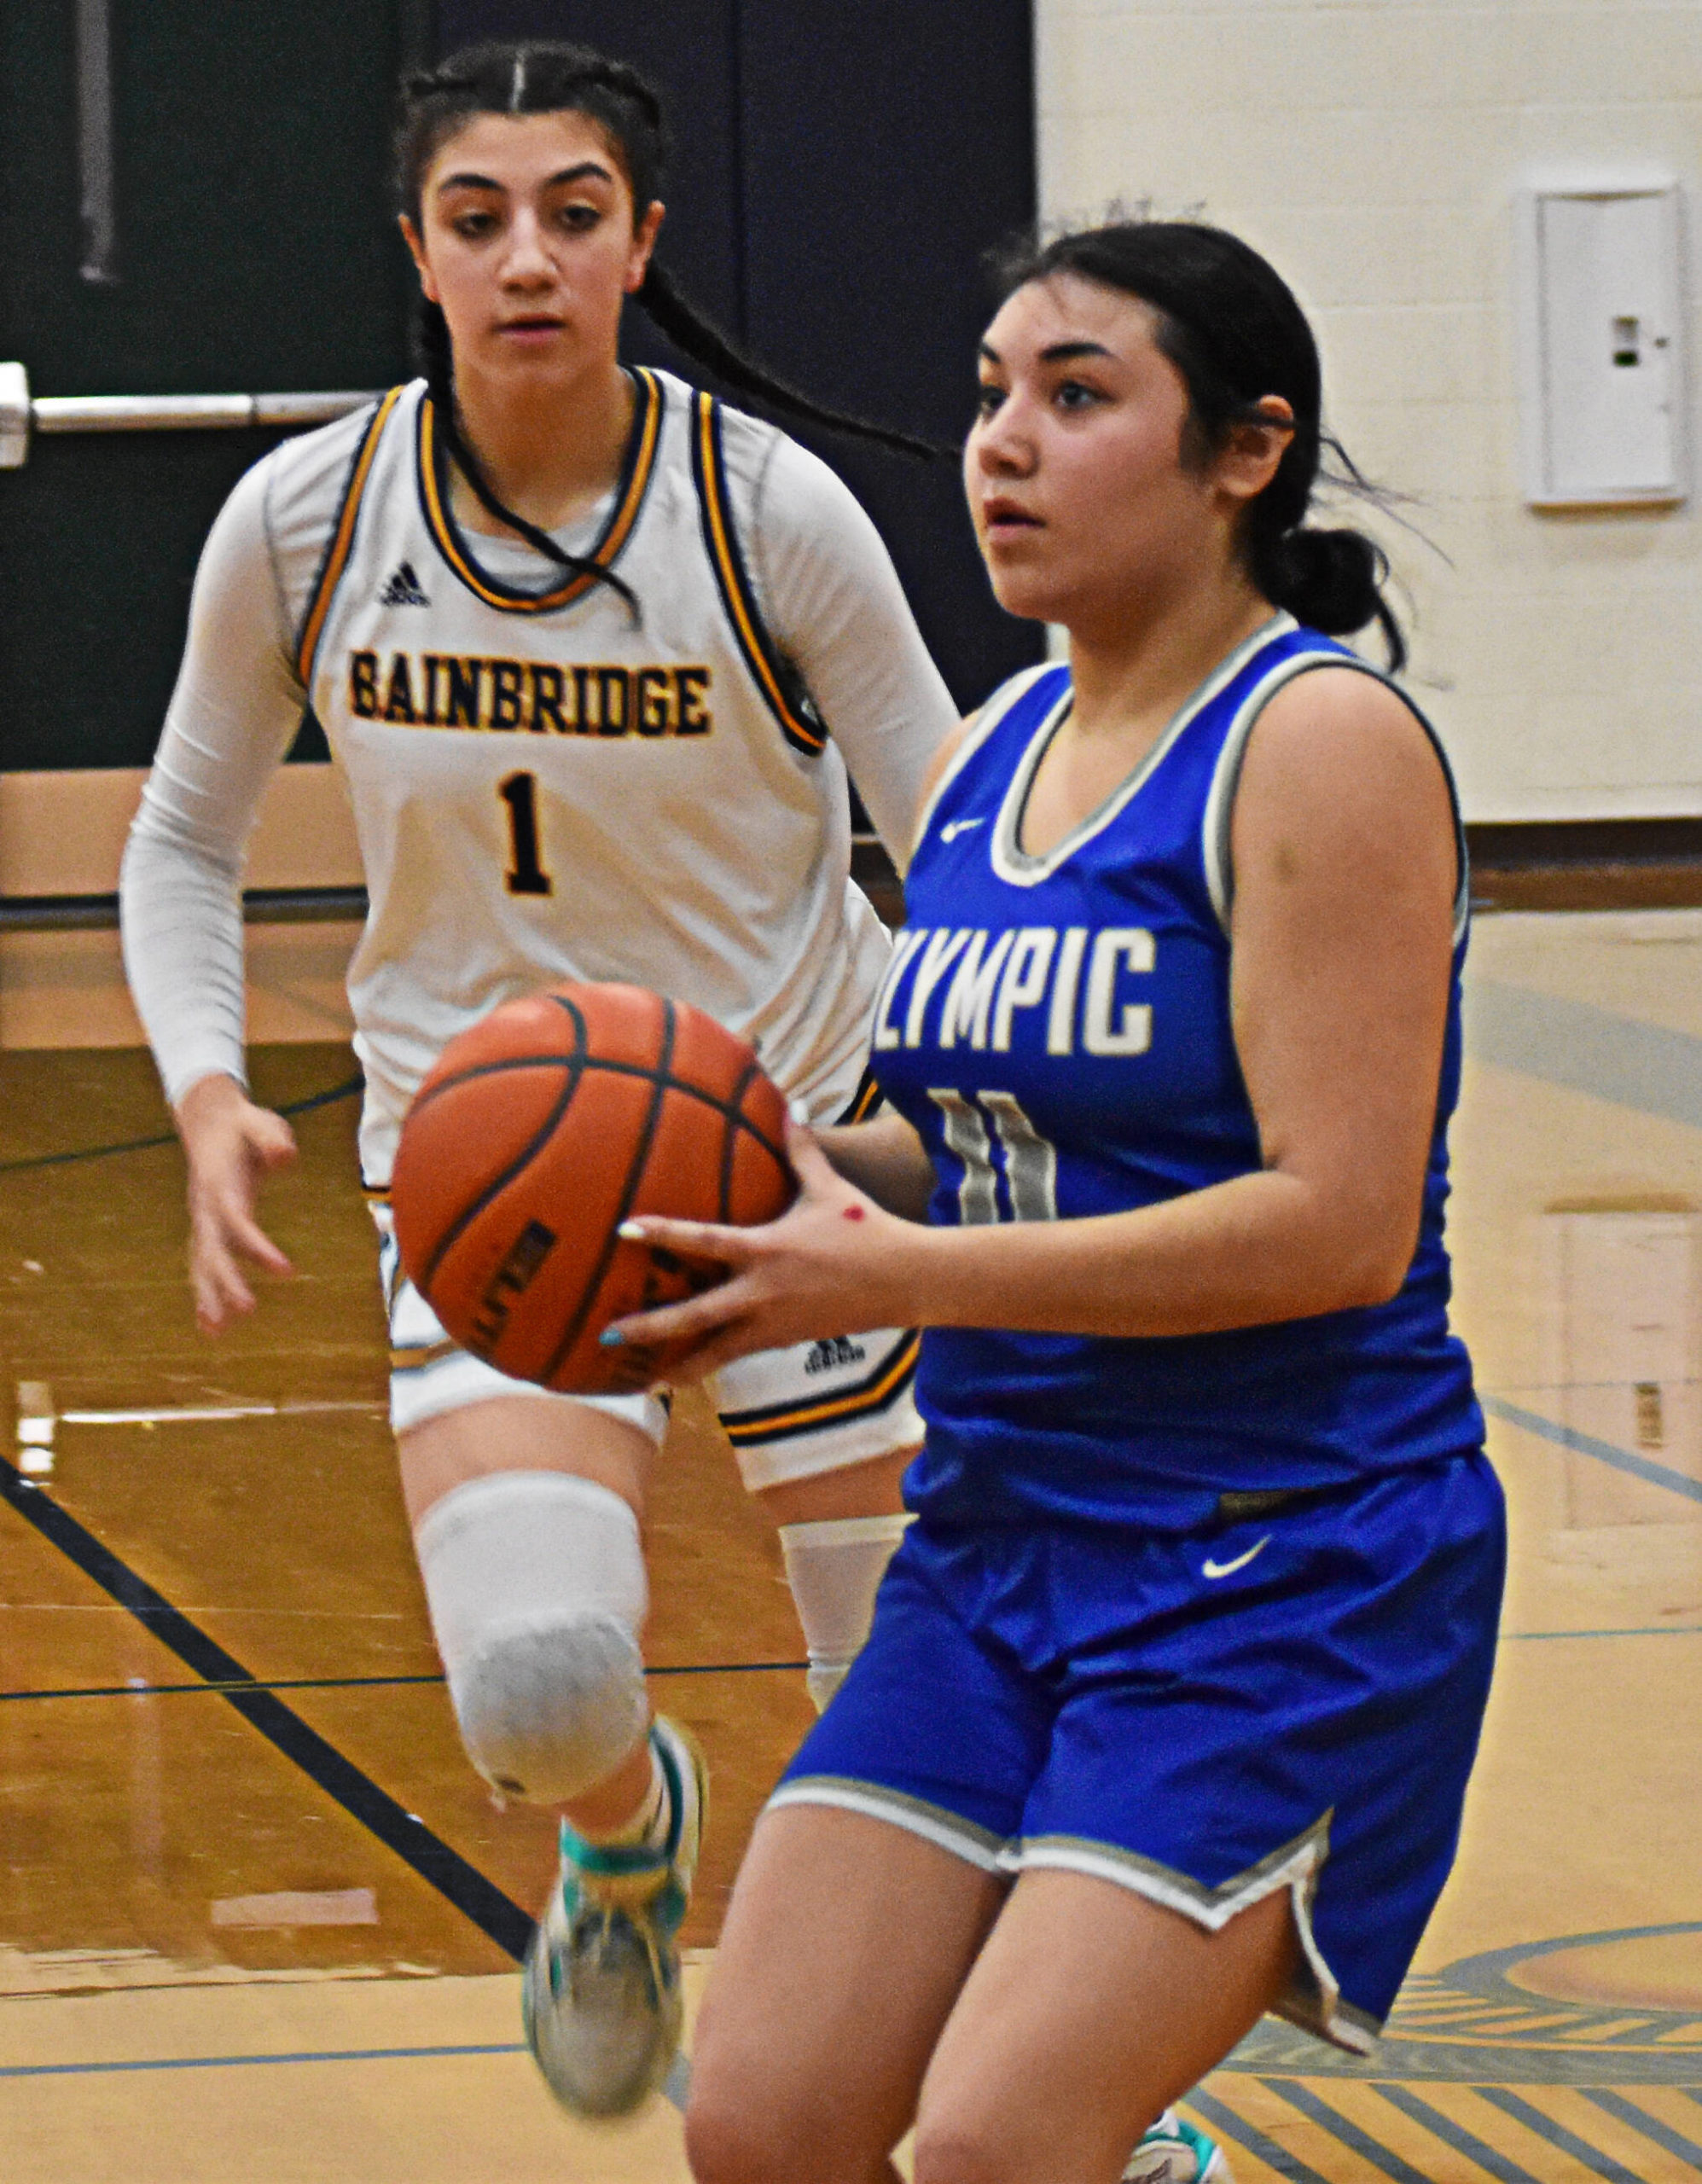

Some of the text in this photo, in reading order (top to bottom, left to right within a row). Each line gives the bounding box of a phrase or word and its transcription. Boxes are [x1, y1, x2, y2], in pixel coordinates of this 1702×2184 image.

[350, 648, 712, 739] BAINBRIDGE
[497, 770, 553, 897] 1
[875, 926, 1156, 1056] LYMPIC
